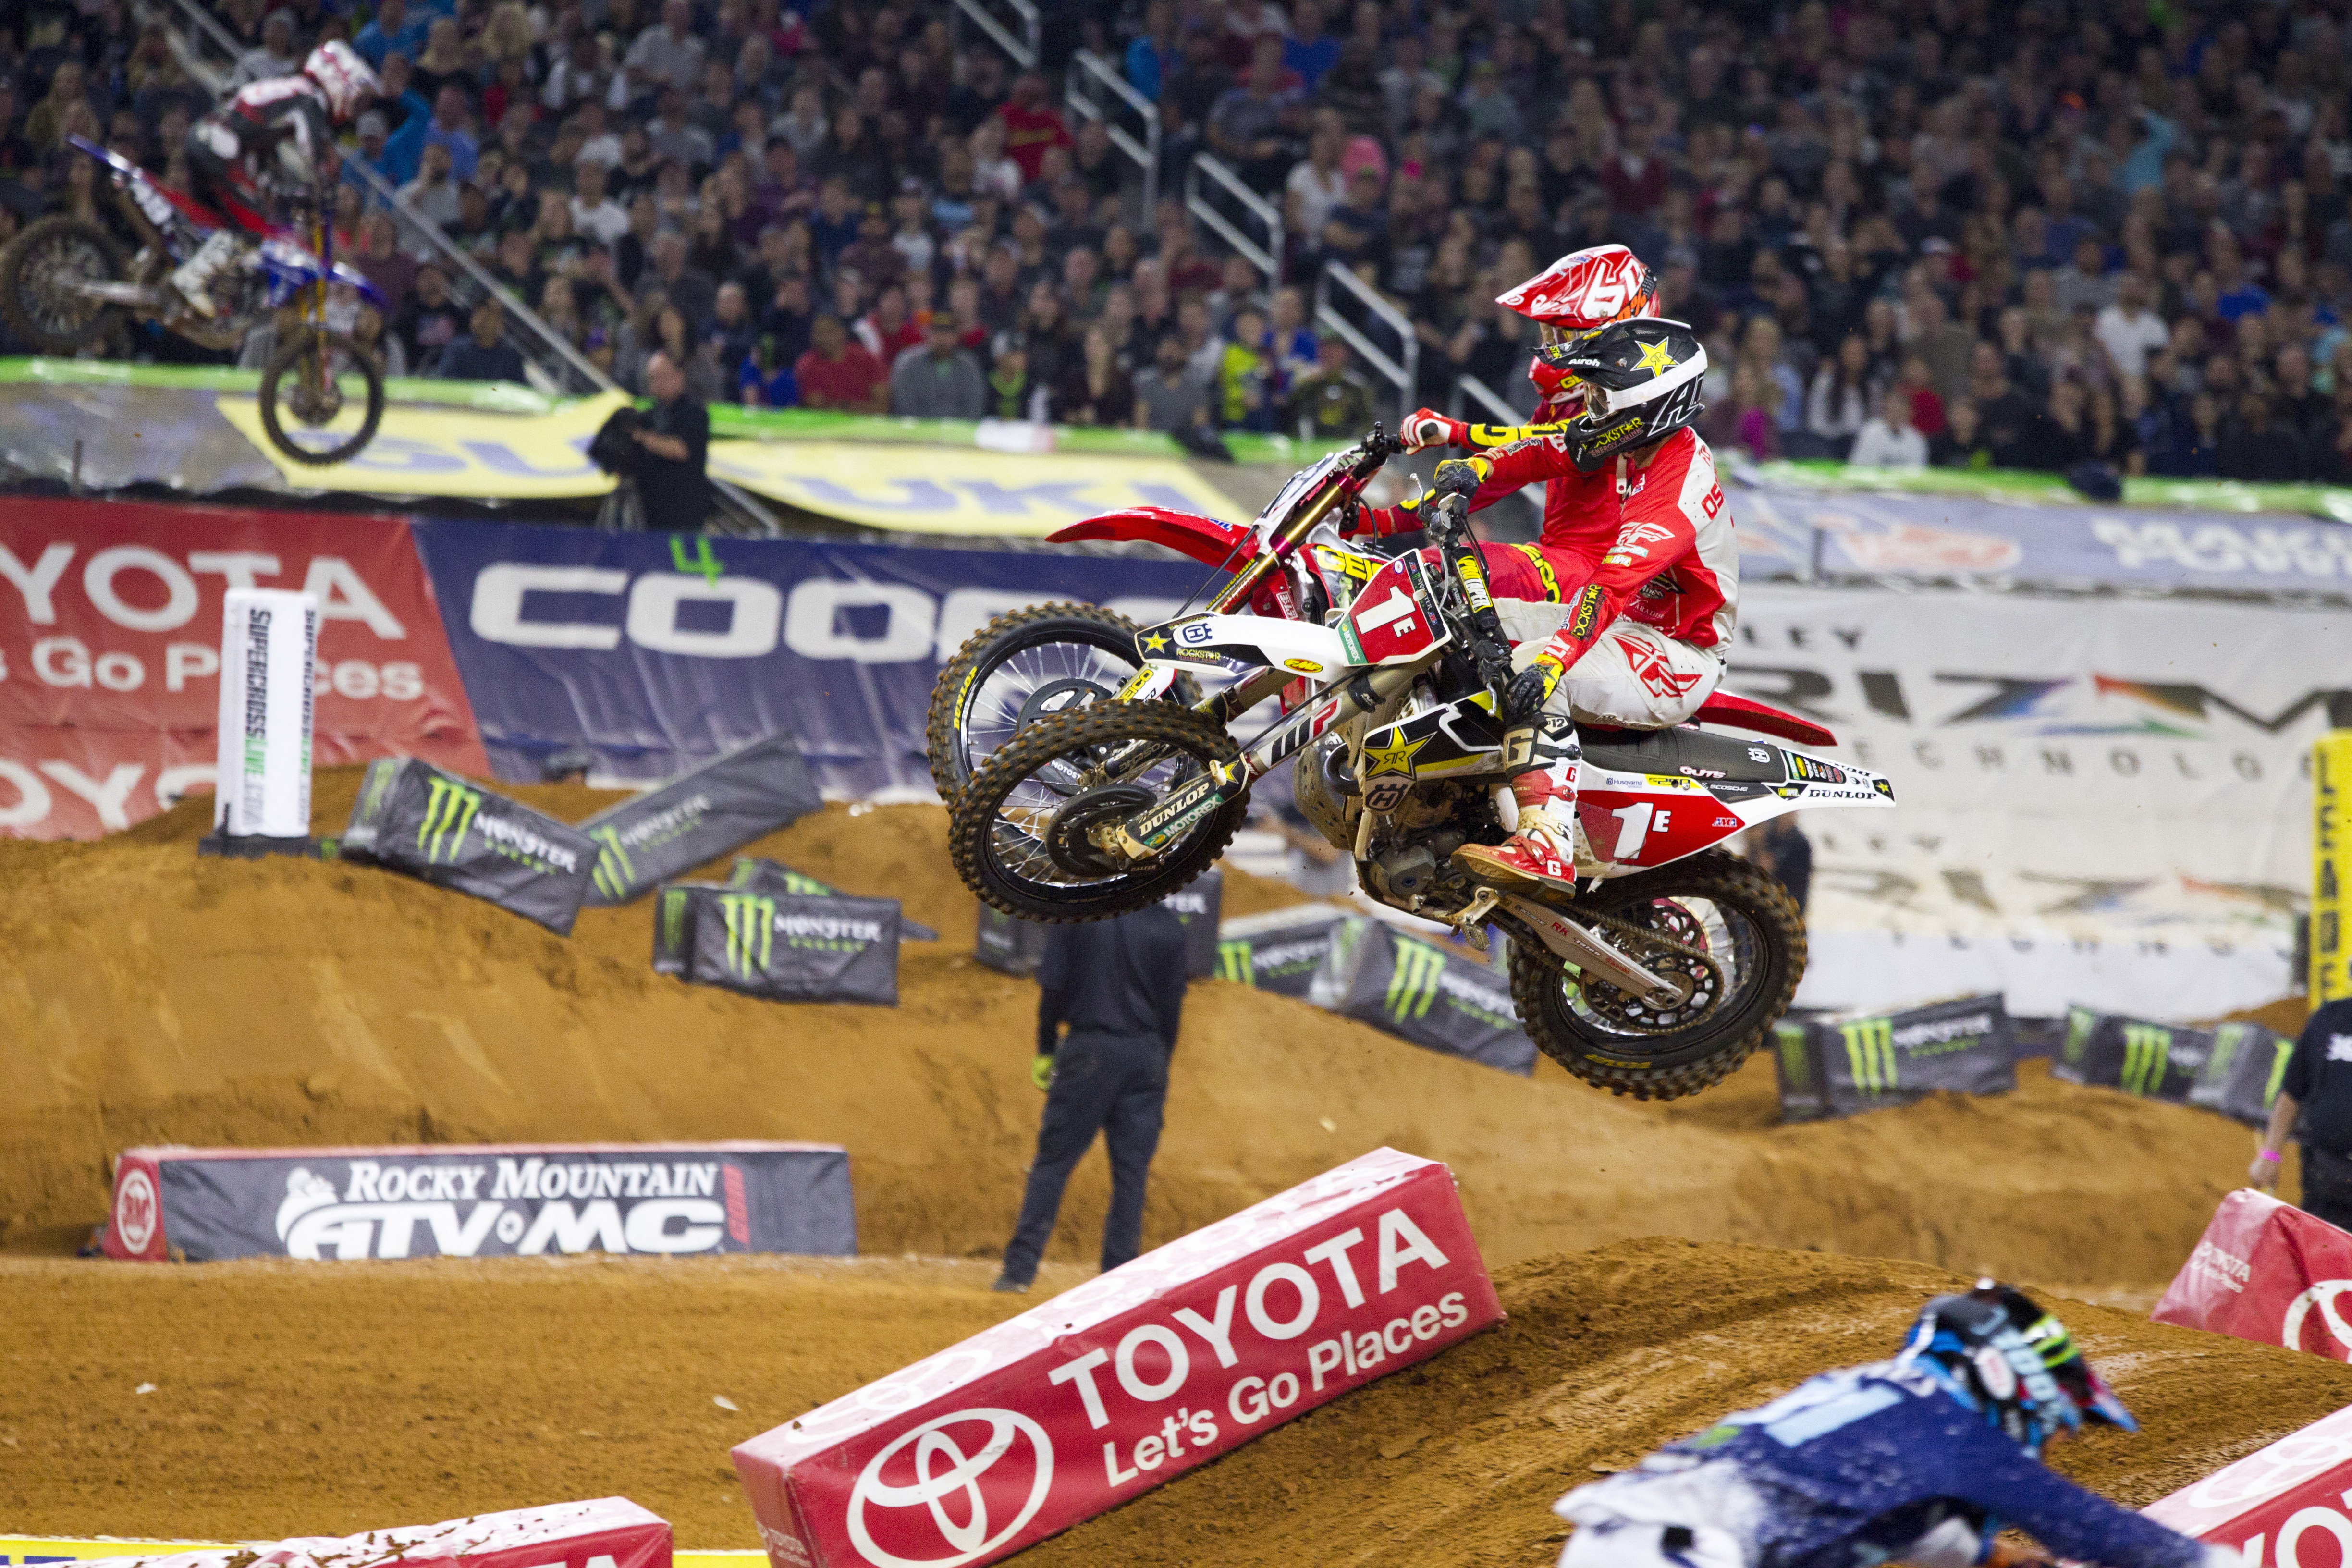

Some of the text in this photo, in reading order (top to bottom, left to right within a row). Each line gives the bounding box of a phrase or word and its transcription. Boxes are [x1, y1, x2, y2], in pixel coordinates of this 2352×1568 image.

[1317, 545, 1383, 582] GEI
[1343, 629, 1360, 662] MOTOREX
[1741, 625, 1863, 650] LEY
[31, 637, 146, 692] Go
[1679, 766, 1727, 778] GUTS
[1709, 784, 1749, 792] SCOSCHE
[1139, 782, 1210, 837] DUNLOP
[1808, 789, 1877, 800] DUNLOP
[1164, 796, 1221, 838] MOTOREX
[1552, 921, 1569, 937] RK
[343, 1158, 722, 1202] ROCKY MOUNTAIN
[1049, 1207, 1450, 1431] TOYOTA
[1103, 1291, 1469, 1488] Let's Go Places
